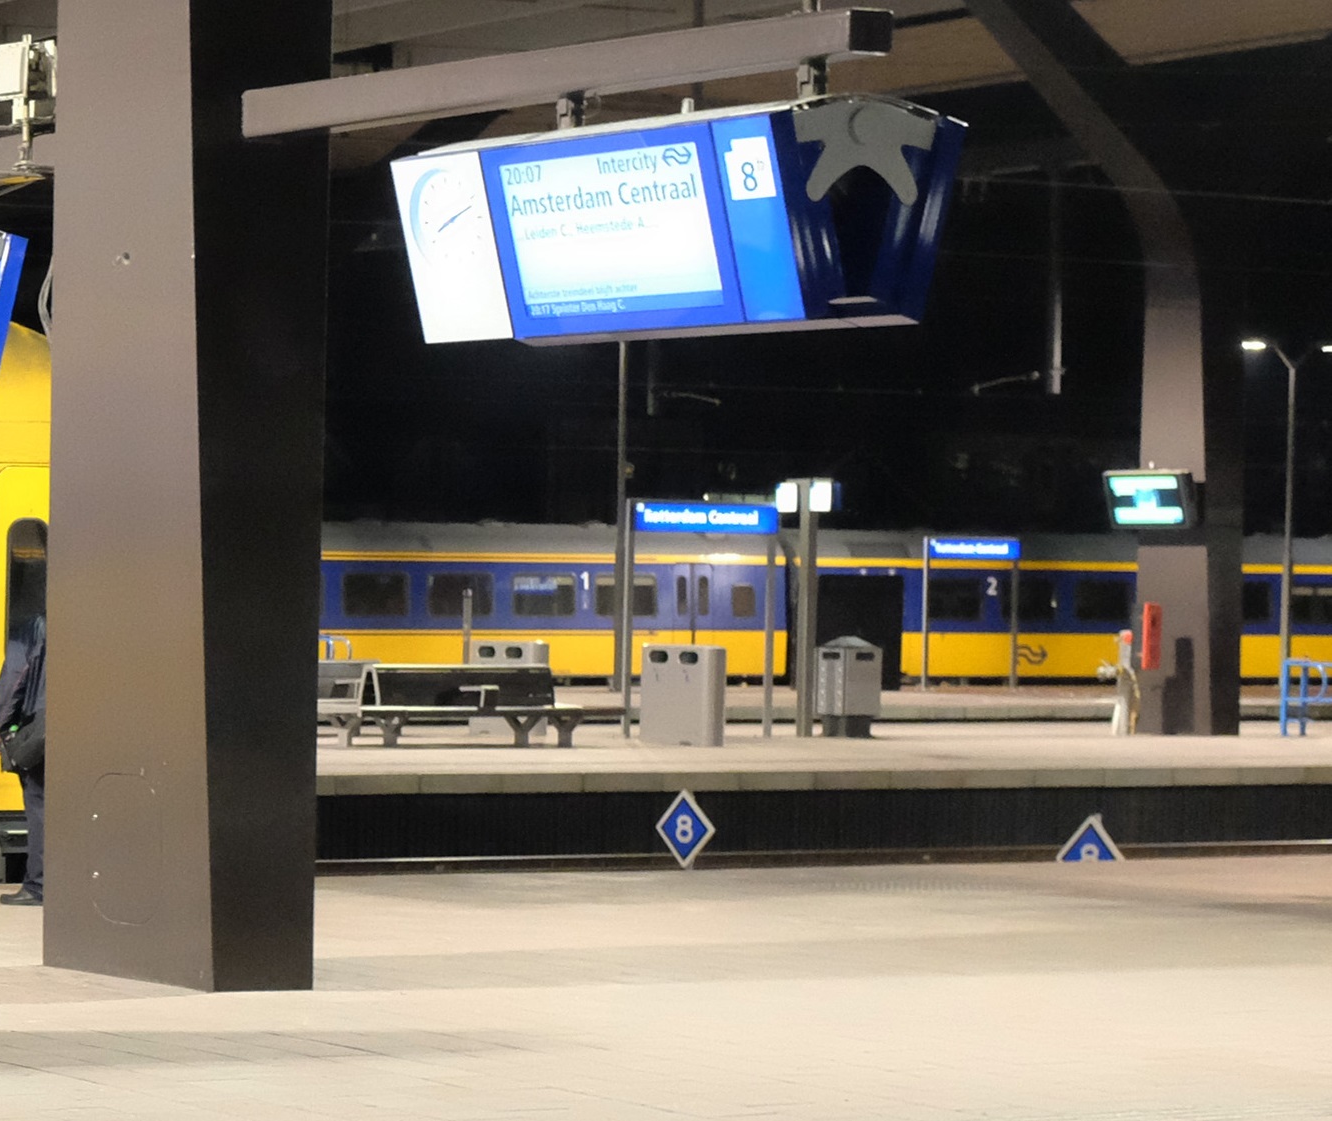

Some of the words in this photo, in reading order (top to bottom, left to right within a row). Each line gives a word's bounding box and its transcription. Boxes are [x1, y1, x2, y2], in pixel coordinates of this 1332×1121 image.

[505, 163, 543, 187] 20:07
[596, 151, 658, 175] Intercity
[741, 161, 758, 192] 8
[511, 186, 612, 217] Amsterdam
[618, 173, 698, 206] Centraal
[579, 571, 590, 591] 1
[985, 576, 998, 596] 2
[675, 814, 694, 844] 8
